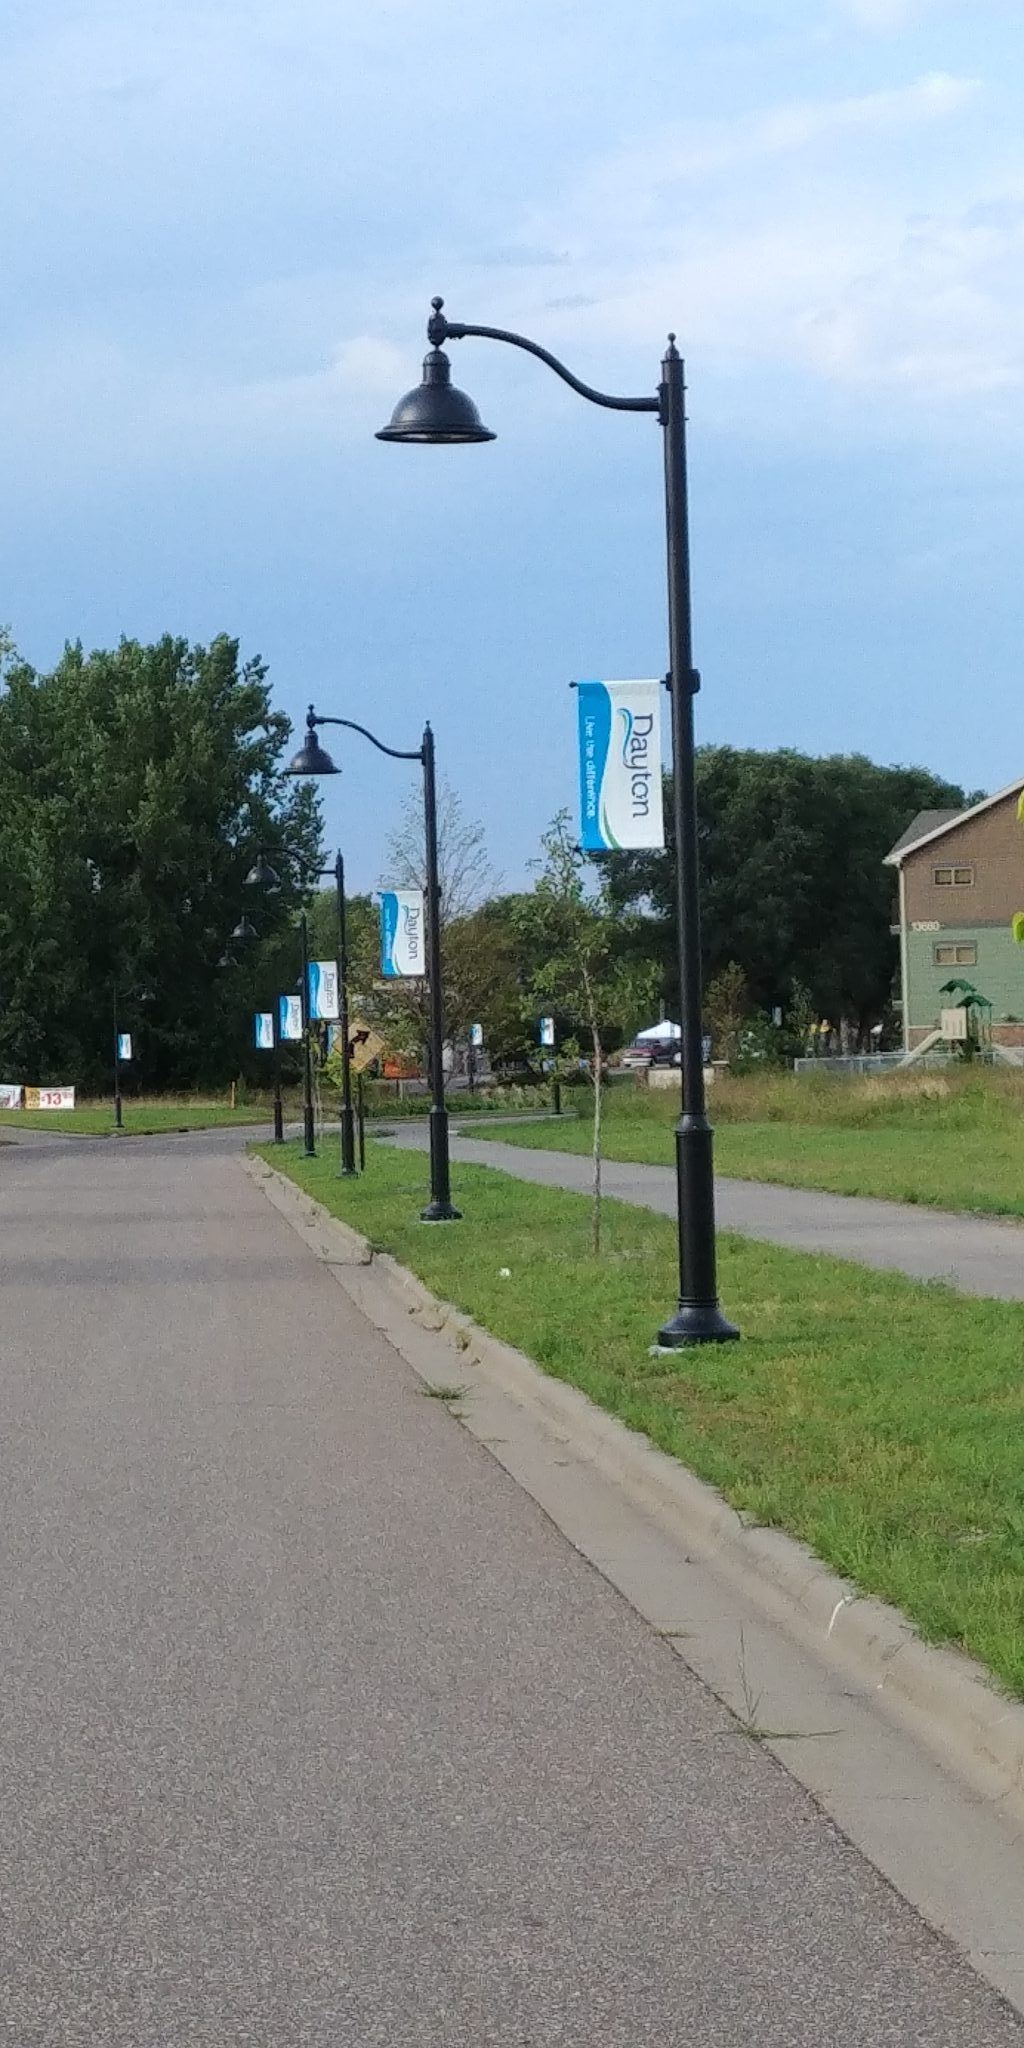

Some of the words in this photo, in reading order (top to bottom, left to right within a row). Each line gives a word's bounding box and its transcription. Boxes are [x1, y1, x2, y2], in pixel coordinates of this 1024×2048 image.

[584, 715, 595, 738] Live
[625, 713, 653, 819] Dayton
[406, 907, 420, 960] Dayton
